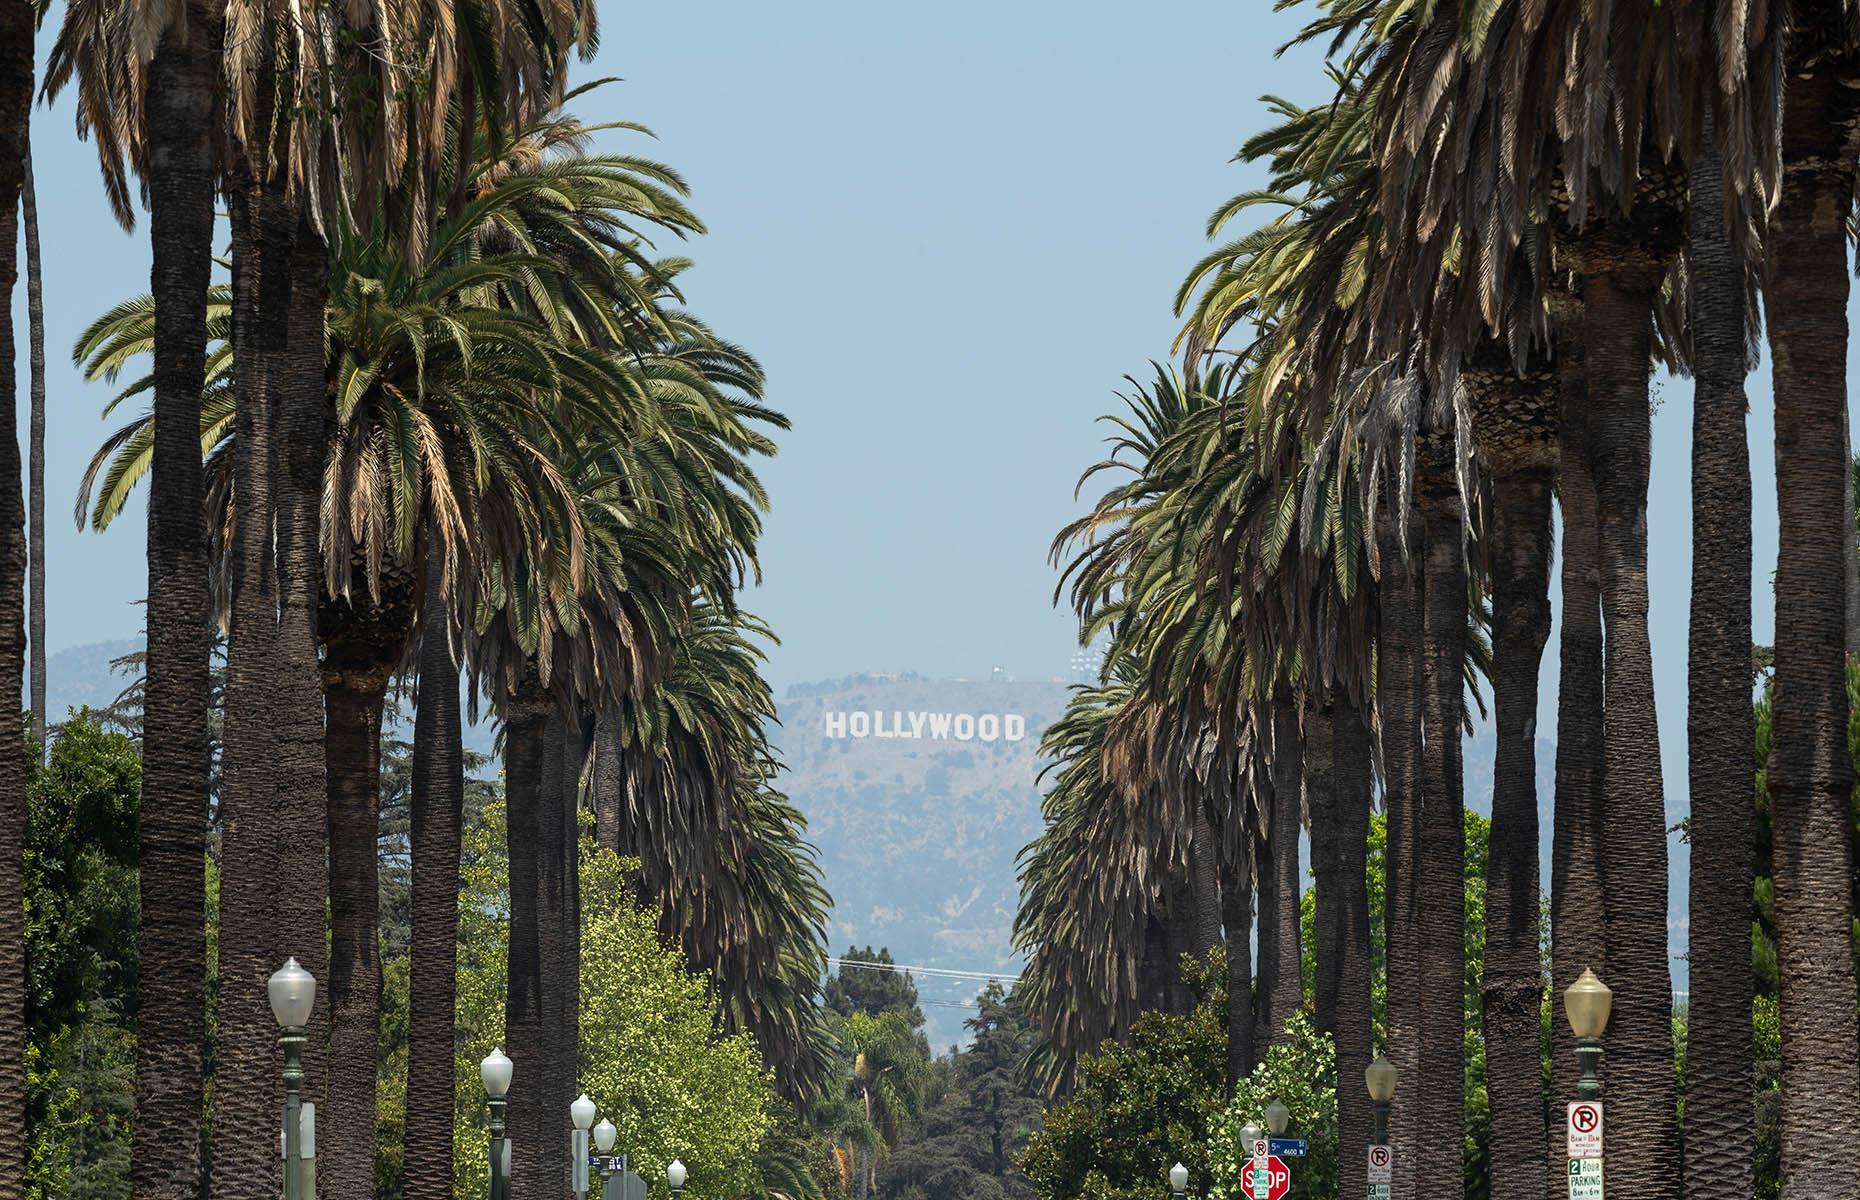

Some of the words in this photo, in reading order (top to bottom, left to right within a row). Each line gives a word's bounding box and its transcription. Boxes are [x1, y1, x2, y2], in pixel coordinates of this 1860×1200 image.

[825, 710, 1025, 741] HOLLYWOOD
[1571, 1161, 1579, 1173] 2
[1582, 1161, 1600, 1172] HOUR
[1245, 1171, 1286, 1188] SOP
[1571, 1175, 1601, 1187] PARKING
[1369, 1185, 1375, 1194] 2
